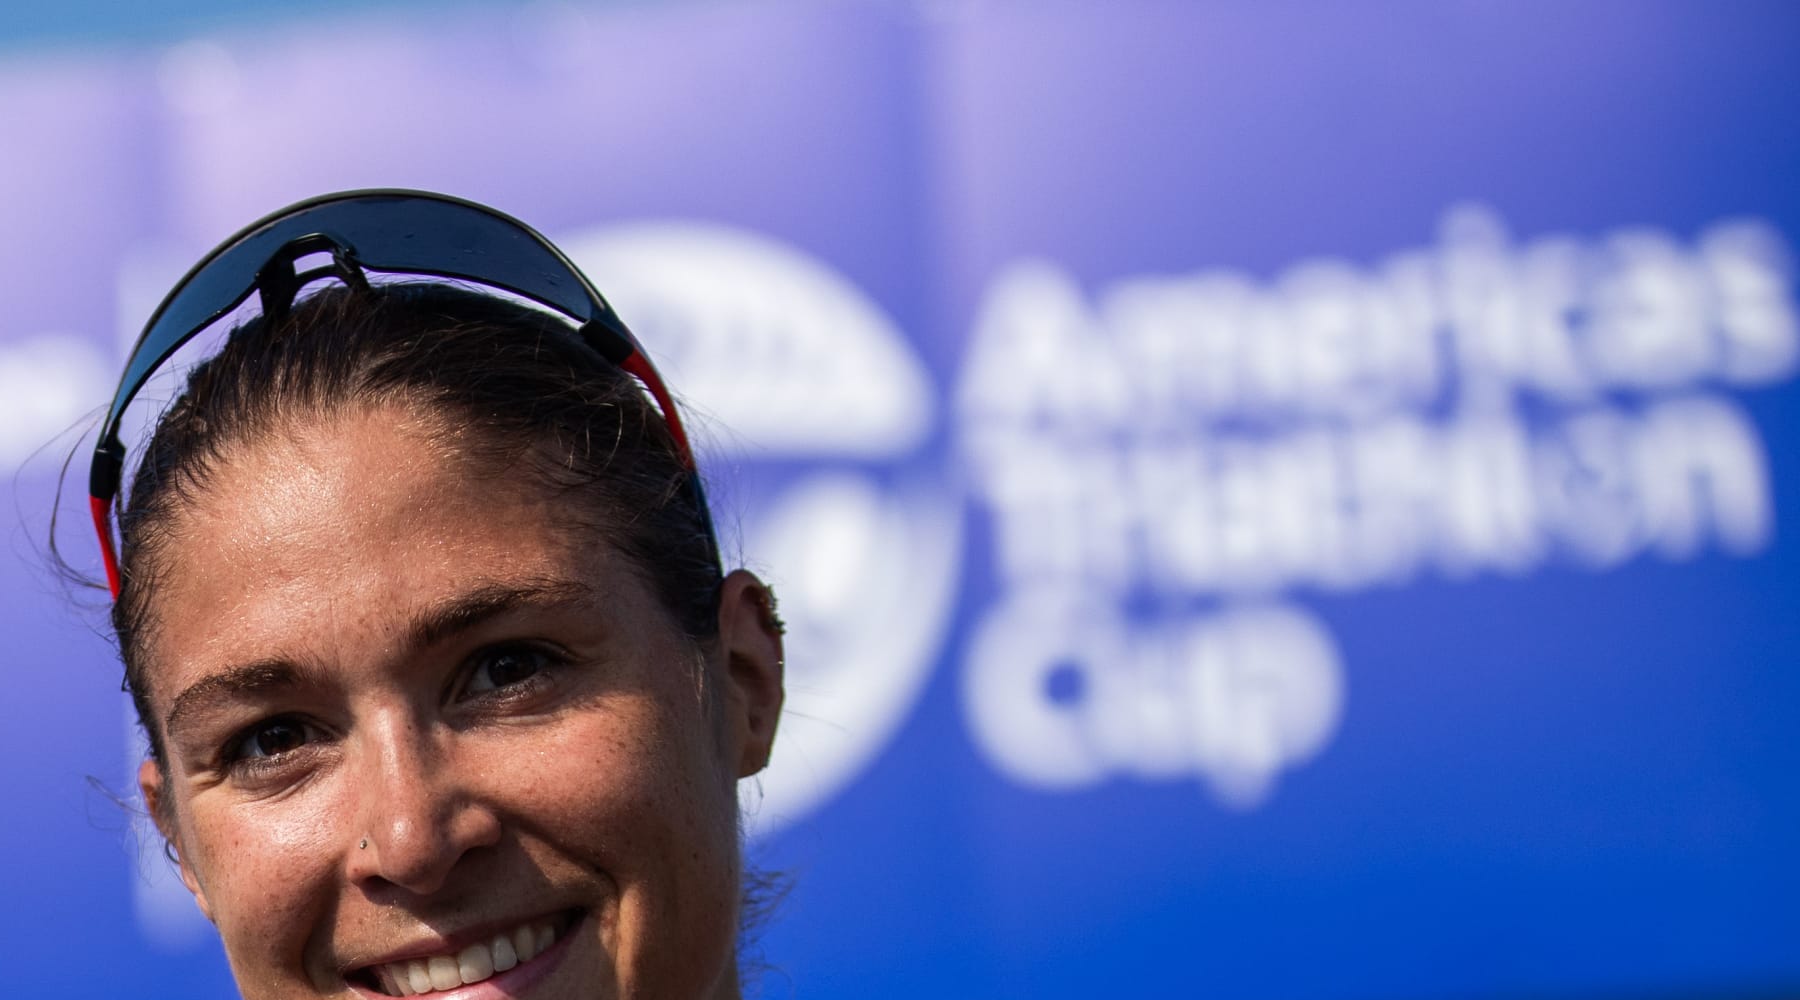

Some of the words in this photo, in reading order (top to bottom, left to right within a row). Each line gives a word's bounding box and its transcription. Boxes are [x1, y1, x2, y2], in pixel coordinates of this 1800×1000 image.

[956, 202, 1798, 414] Americas
[965, 398, 1770, 598] Triathlon
[958, 602, 1348, 812] Cup
